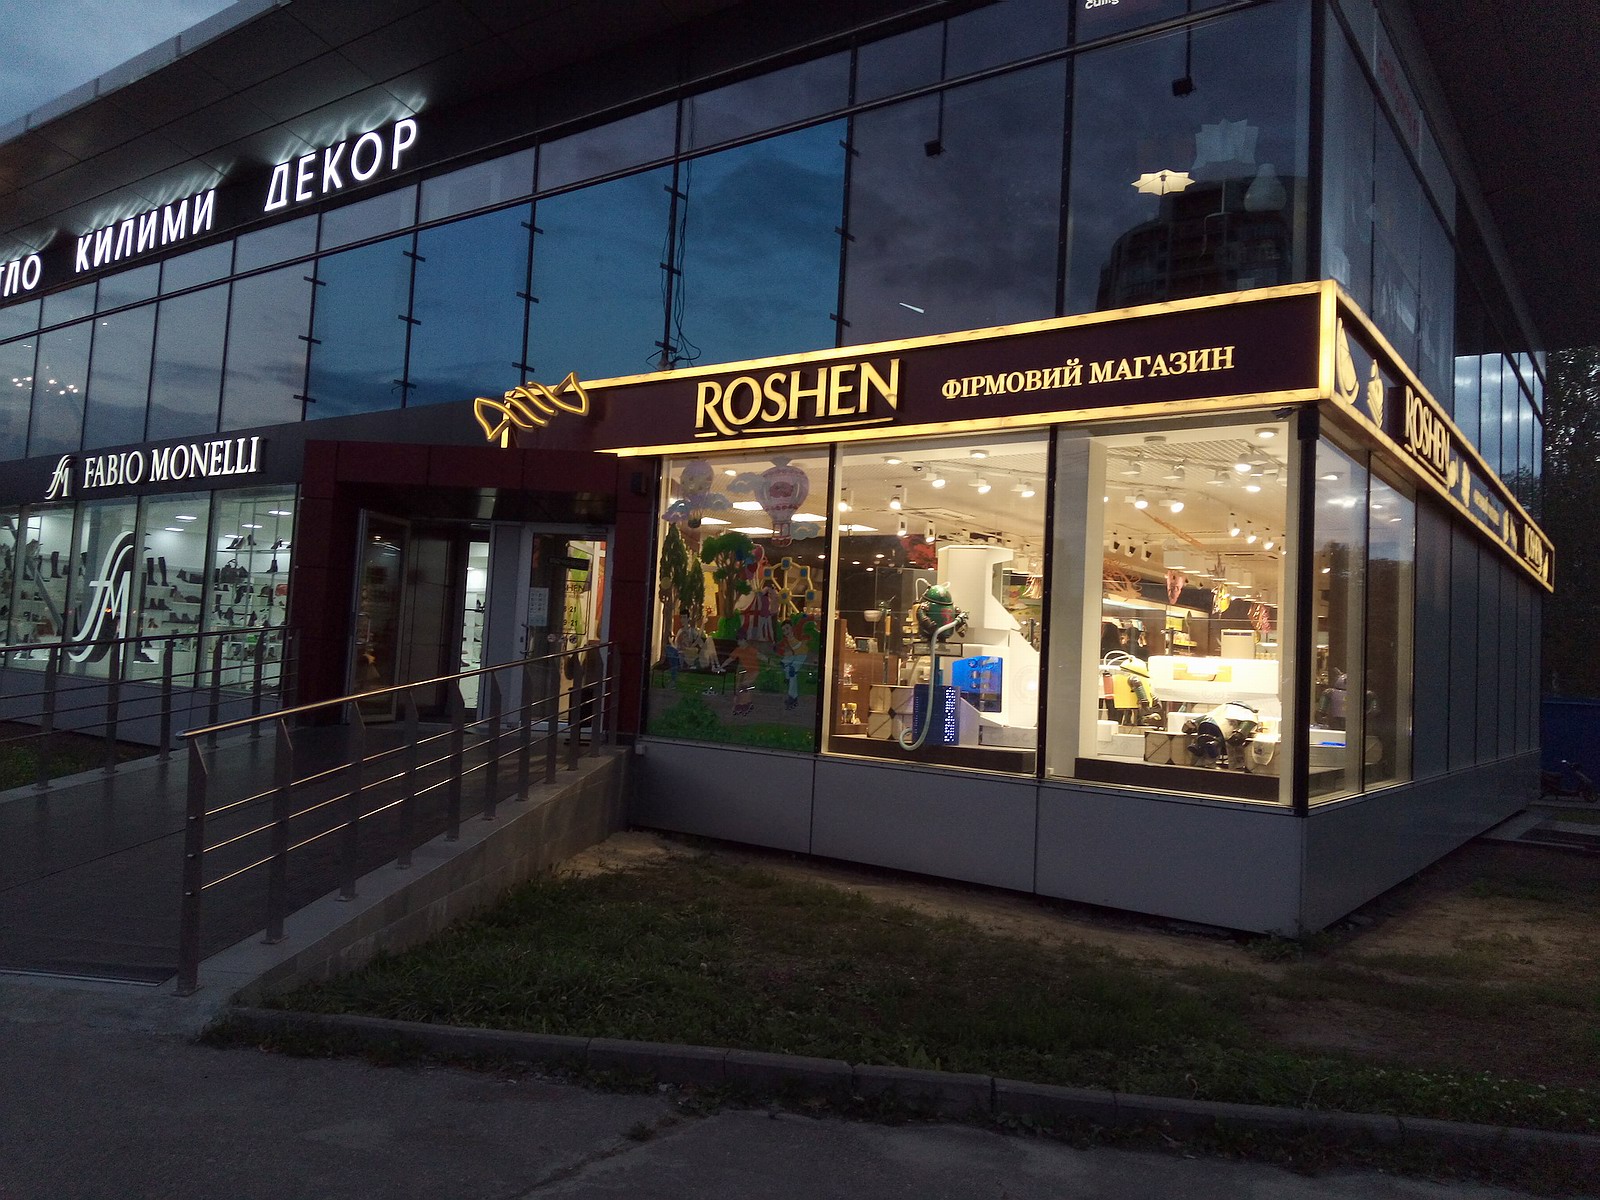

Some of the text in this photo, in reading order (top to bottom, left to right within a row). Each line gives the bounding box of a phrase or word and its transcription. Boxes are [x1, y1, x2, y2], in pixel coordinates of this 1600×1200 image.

[75, 189, 216, 273] КИЛИМИ
[264, 118, 418, 212] ДЕКОР
[694, 358, 901, 436] ROSHEN
[941, 346, 1236, 400] ФІРМОВИЙ МАГАЗИН
[83, 450, 144, 489] FABIO
[149, 436, 261, 482] MONELLI
[1405, 385, 1450, 473] ROSHEN
